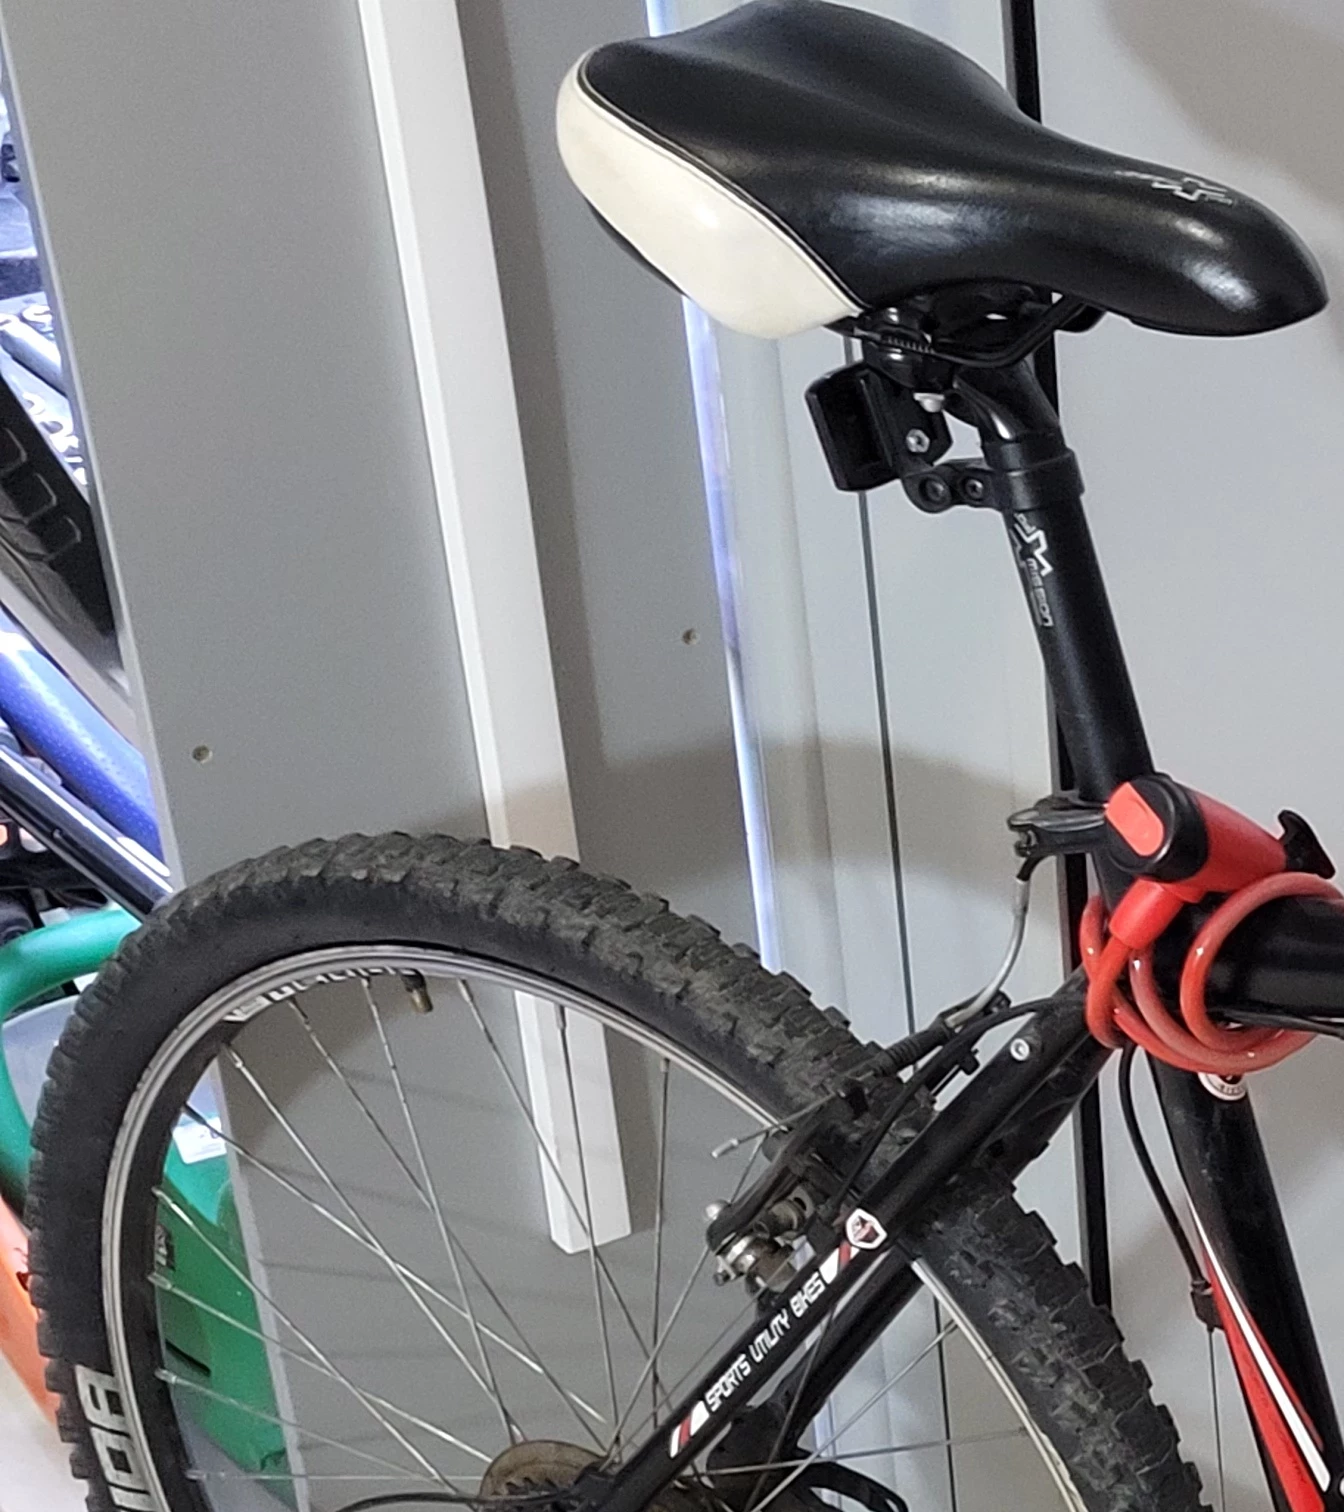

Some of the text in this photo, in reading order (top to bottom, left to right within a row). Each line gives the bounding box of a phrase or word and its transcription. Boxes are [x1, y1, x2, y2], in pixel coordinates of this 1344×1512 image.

[704, 1271, 826, 1412] SPORTS UTILITY BIKES
